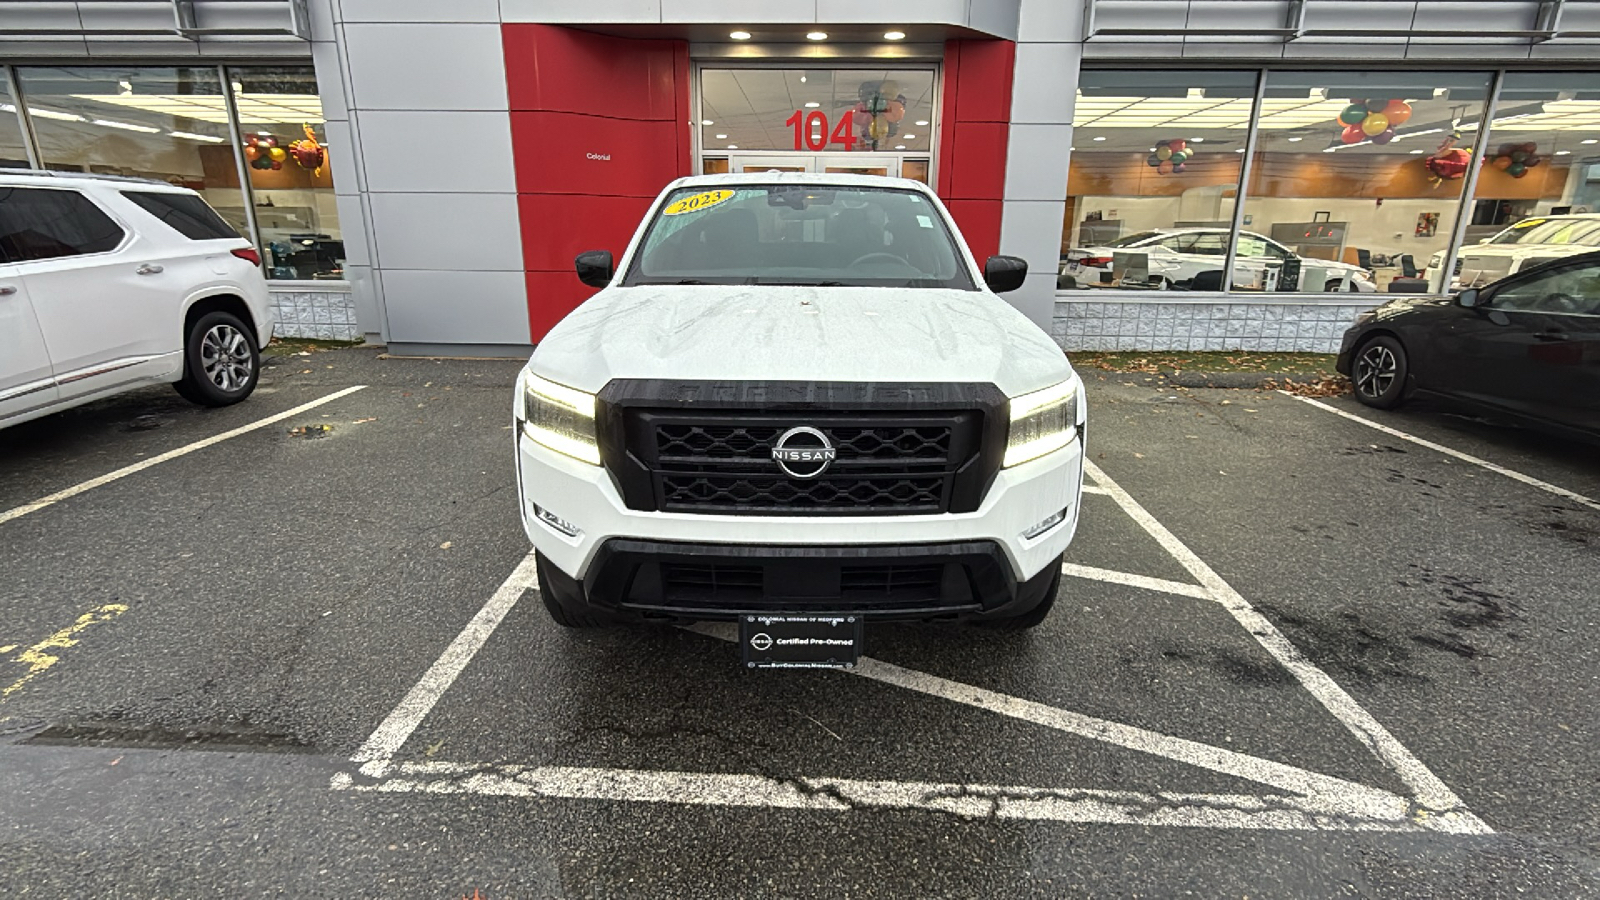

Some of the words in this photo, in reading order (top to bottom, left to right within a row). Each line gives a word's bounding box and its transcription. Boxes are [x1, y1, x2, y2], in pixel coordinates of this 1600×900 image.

[786, 109, 857, 151] 104
[586, 152, 611, 161] Colonial
[678, 191, 721, 213] 2023
[772, 450, 835, 461] NISSAN
[776, 638, 809, 646] Certified
[809, 638, 854, 646] Pre-Owned
